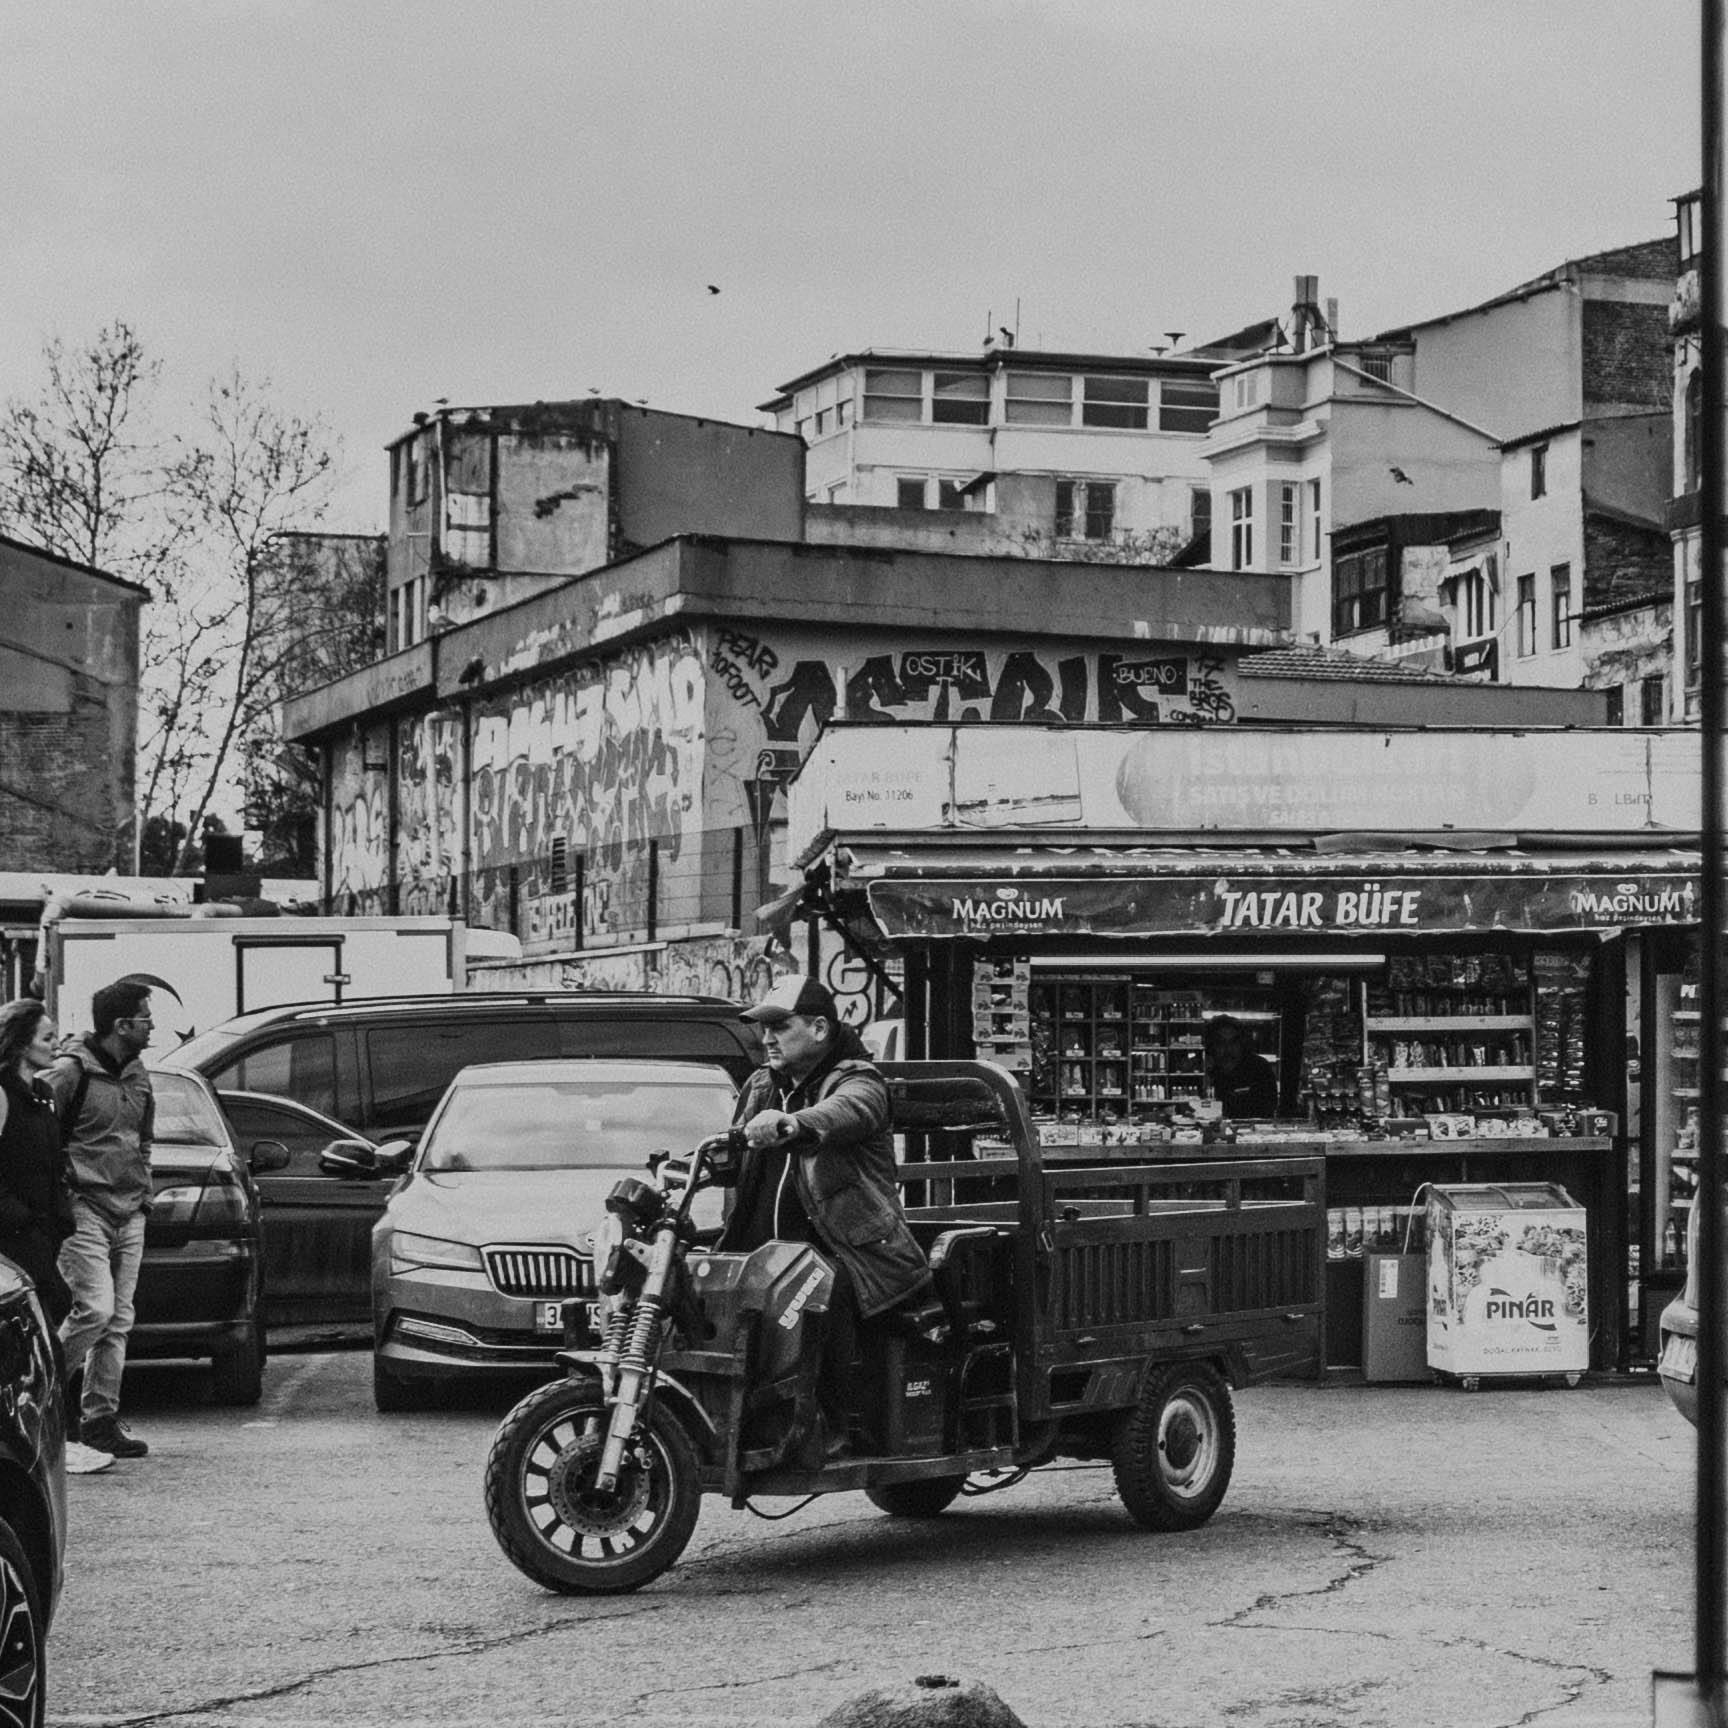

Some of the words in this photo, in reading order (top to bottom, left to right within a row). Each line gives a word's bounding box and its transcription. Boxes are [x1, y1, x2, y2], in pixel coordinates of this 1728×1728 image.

[1115, 664, 1177, 686] BUENO
[885, 788, 914, 801] 11206
[952, 896, 1067, 919] MAGNUM
[1220, 891, 1325, 925] TATAR
[1335, 883, 1422, 923] BÜFE
[1575, 891, 1681, 913] MAGNUM
